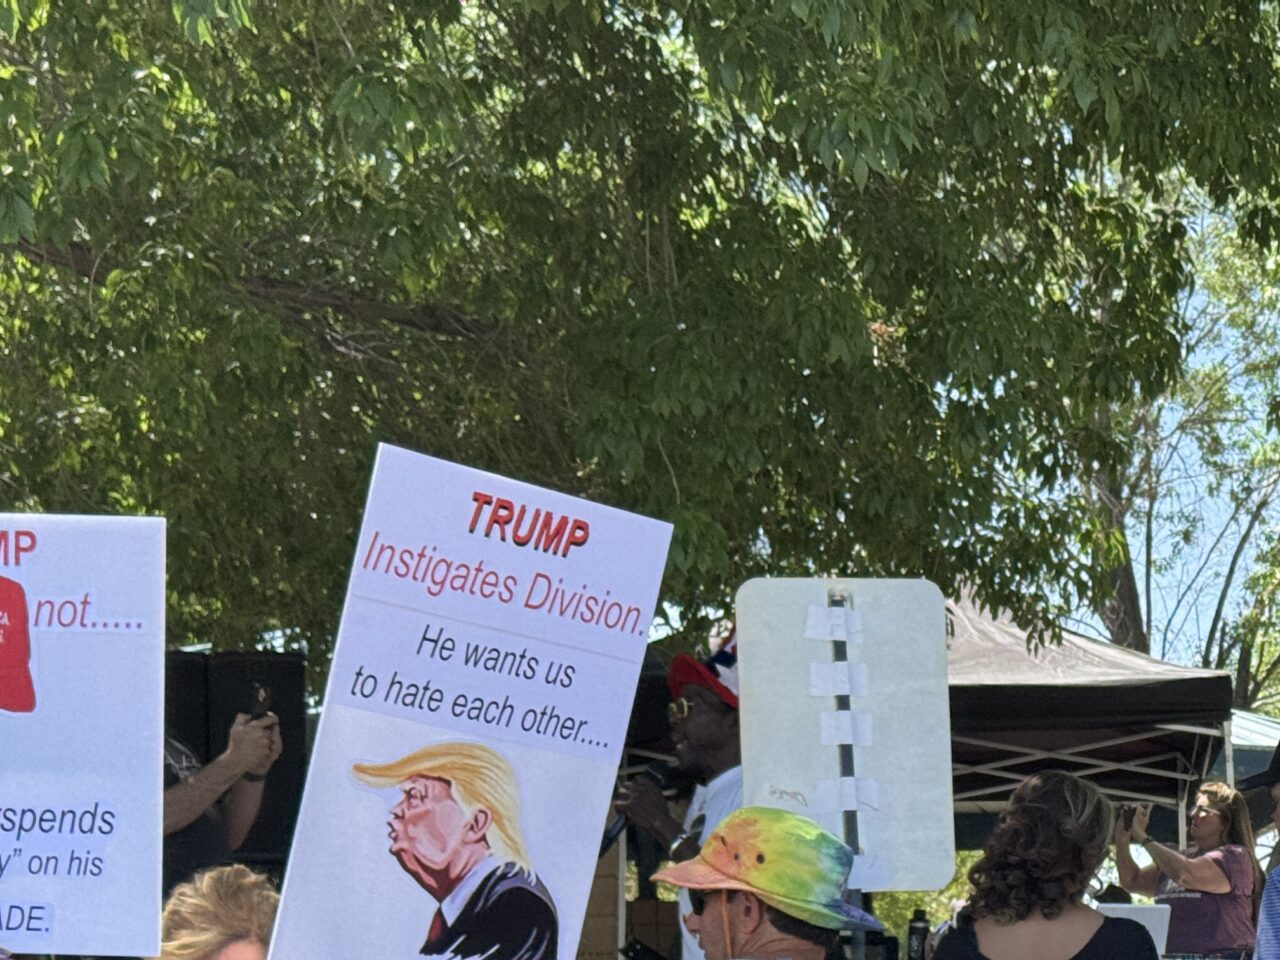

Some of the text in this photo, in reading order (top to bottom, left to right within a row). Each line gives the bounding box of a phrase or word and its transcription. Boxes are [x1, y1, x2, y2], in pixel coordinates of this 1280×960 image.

[468, 491, 590, 558] TRUMP
[362, 531, 644, 637] Instigates Division.
[416, 623, 576, 689] He wants us
[350, 665, 377, 699] to
[383, 671, 444, 713] hate
[451, 692, 515, 728] each
[0, 802, 116, 841] spends
[28, 855, 59, 875] on
[67, 849, 104, 877] his
